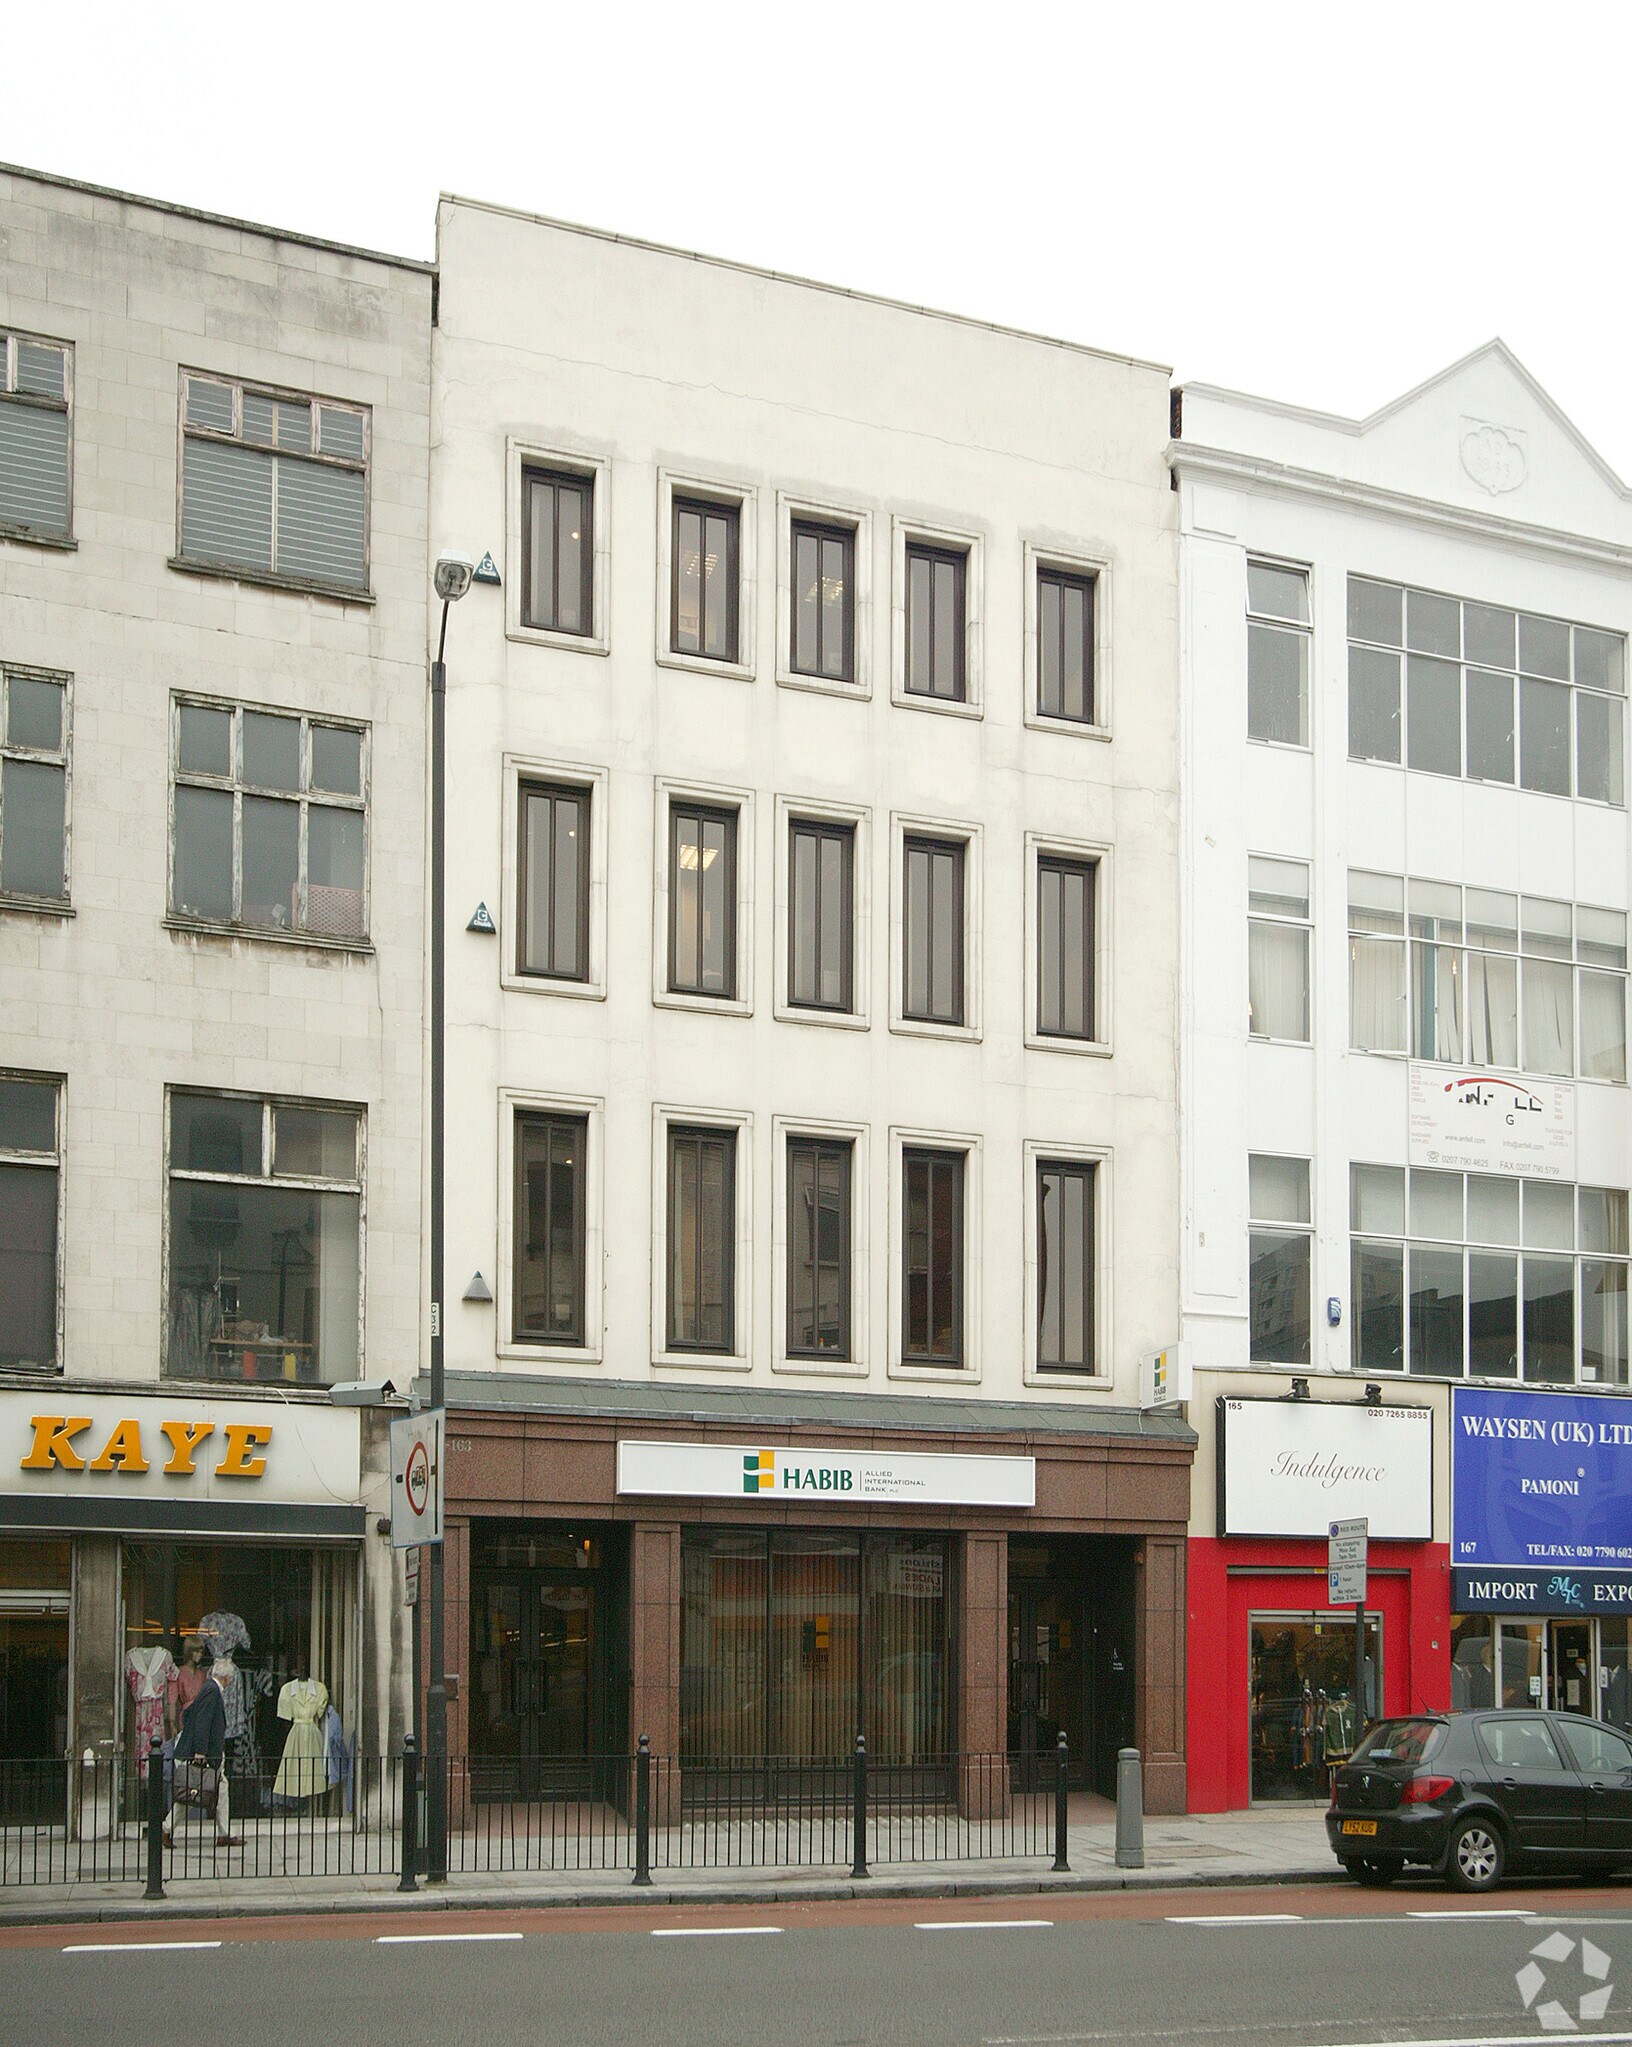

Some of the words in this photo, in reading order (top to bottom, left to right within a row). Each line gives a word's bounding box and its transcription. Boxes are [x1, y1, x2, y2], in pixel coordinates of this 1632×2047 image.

[1505, 1114, 1516, 1126] G
[1500, 1161, 1514, 1170] FAX
[1228, 1402, 1243, 1410] 165
[1368, 1409, 1384, 1417] 020
[1461, 1415, 1546, 1443] WAYSEN
[1551, 1420, 1595, 1448] (UK)
[20, 1414, 273, 1477] KAYE
[452, 1439, 472, 1452] 163
[865, 1470, 893, 1478] ALLIED
[1270, 1450, 1389, 1489] Indulgence
[783, 1467, 853, 1491] HABIB
[865, 1478, 926, 1487] INTERNATIONAL
[1521, 1478, 1580, 1497] PAMONI
[1460, 1542, 1477, 1553] 167
[1526, 1543, 1575, 1557] TEL/FAX:
[1576, 1546, 1593, 1558] 020
[1594, 1546, 1615, 1559] 7790
[1467, 1581, 1538, 1601] IMPORT
